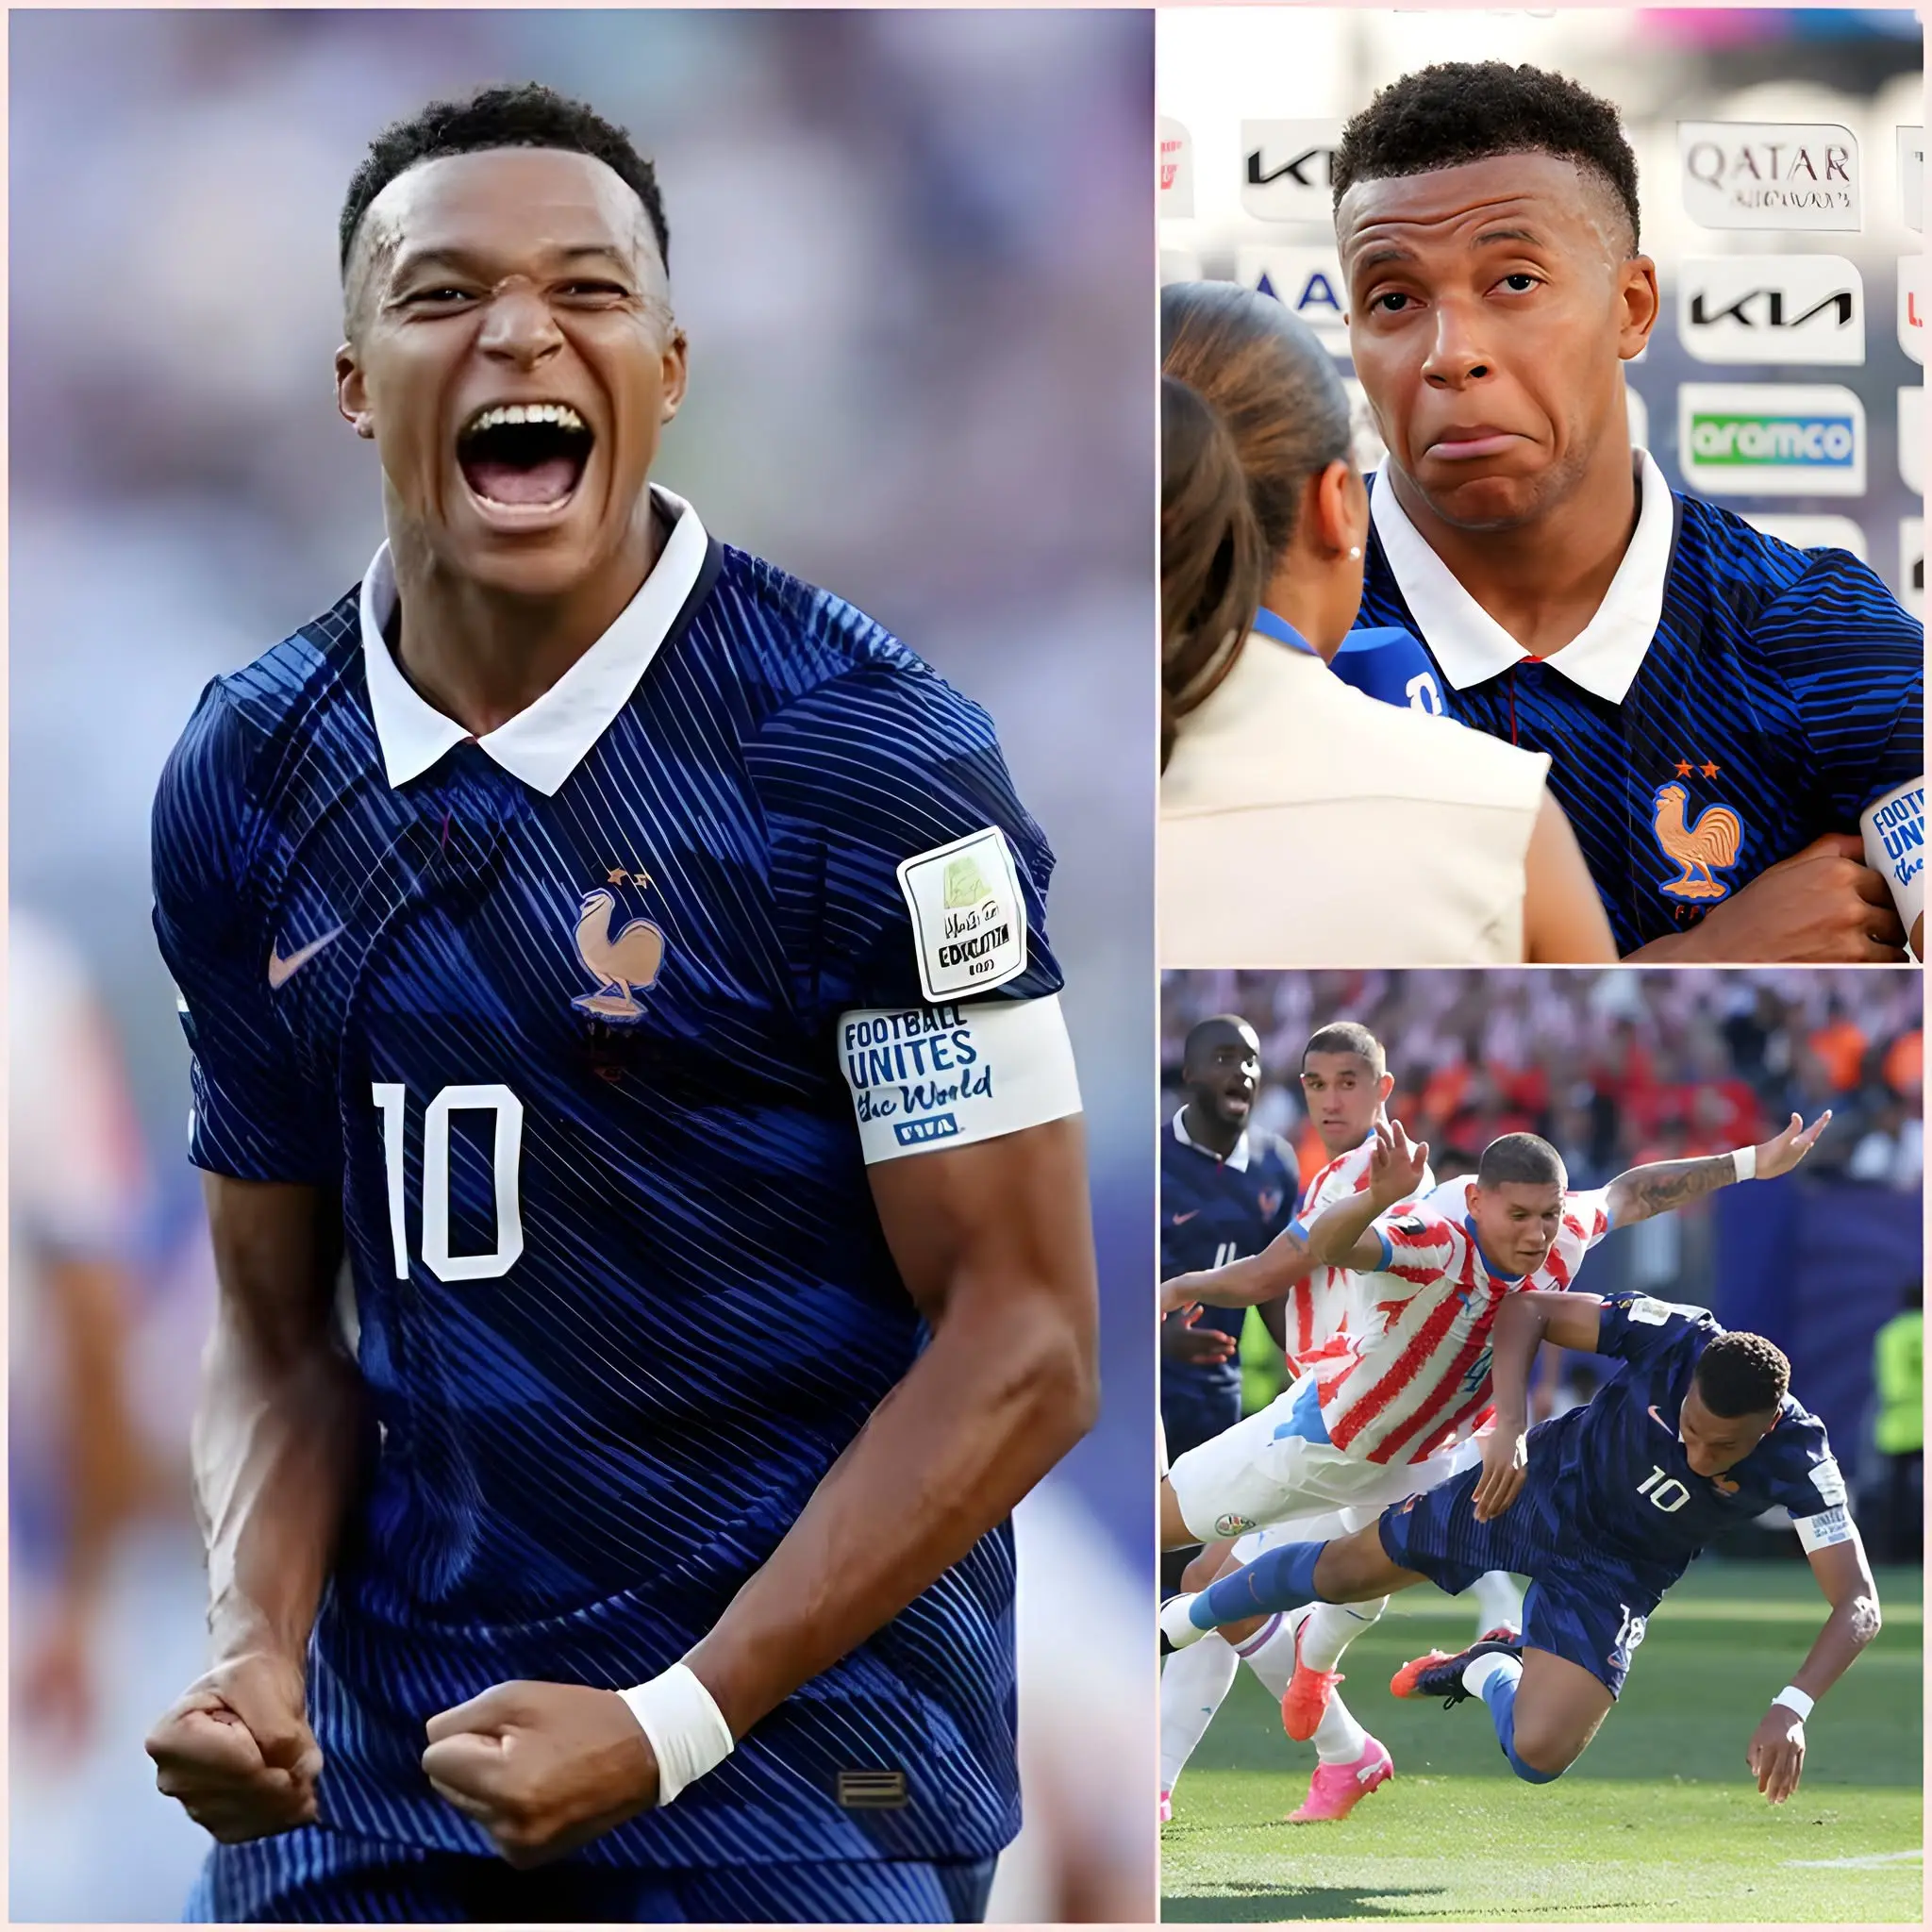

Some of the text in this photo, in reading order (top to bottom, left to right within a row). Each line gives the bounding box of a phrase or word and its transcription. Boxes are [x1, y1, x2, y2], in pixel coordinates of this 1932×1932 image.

[1687, 142, 1850, 189] QATAR
[1691, 291, 1852, 326] KIA
[1692, 422, 1853, 459] aramco
[845, 1003, 968, 1051] FOOTBALL
[848, 1029, 977, 1090] UNITES
[898, 1064, 993, 1114] World
[372, 1081, 525, 1283] 10
[1636, 1464, 1690, 1512] 10
